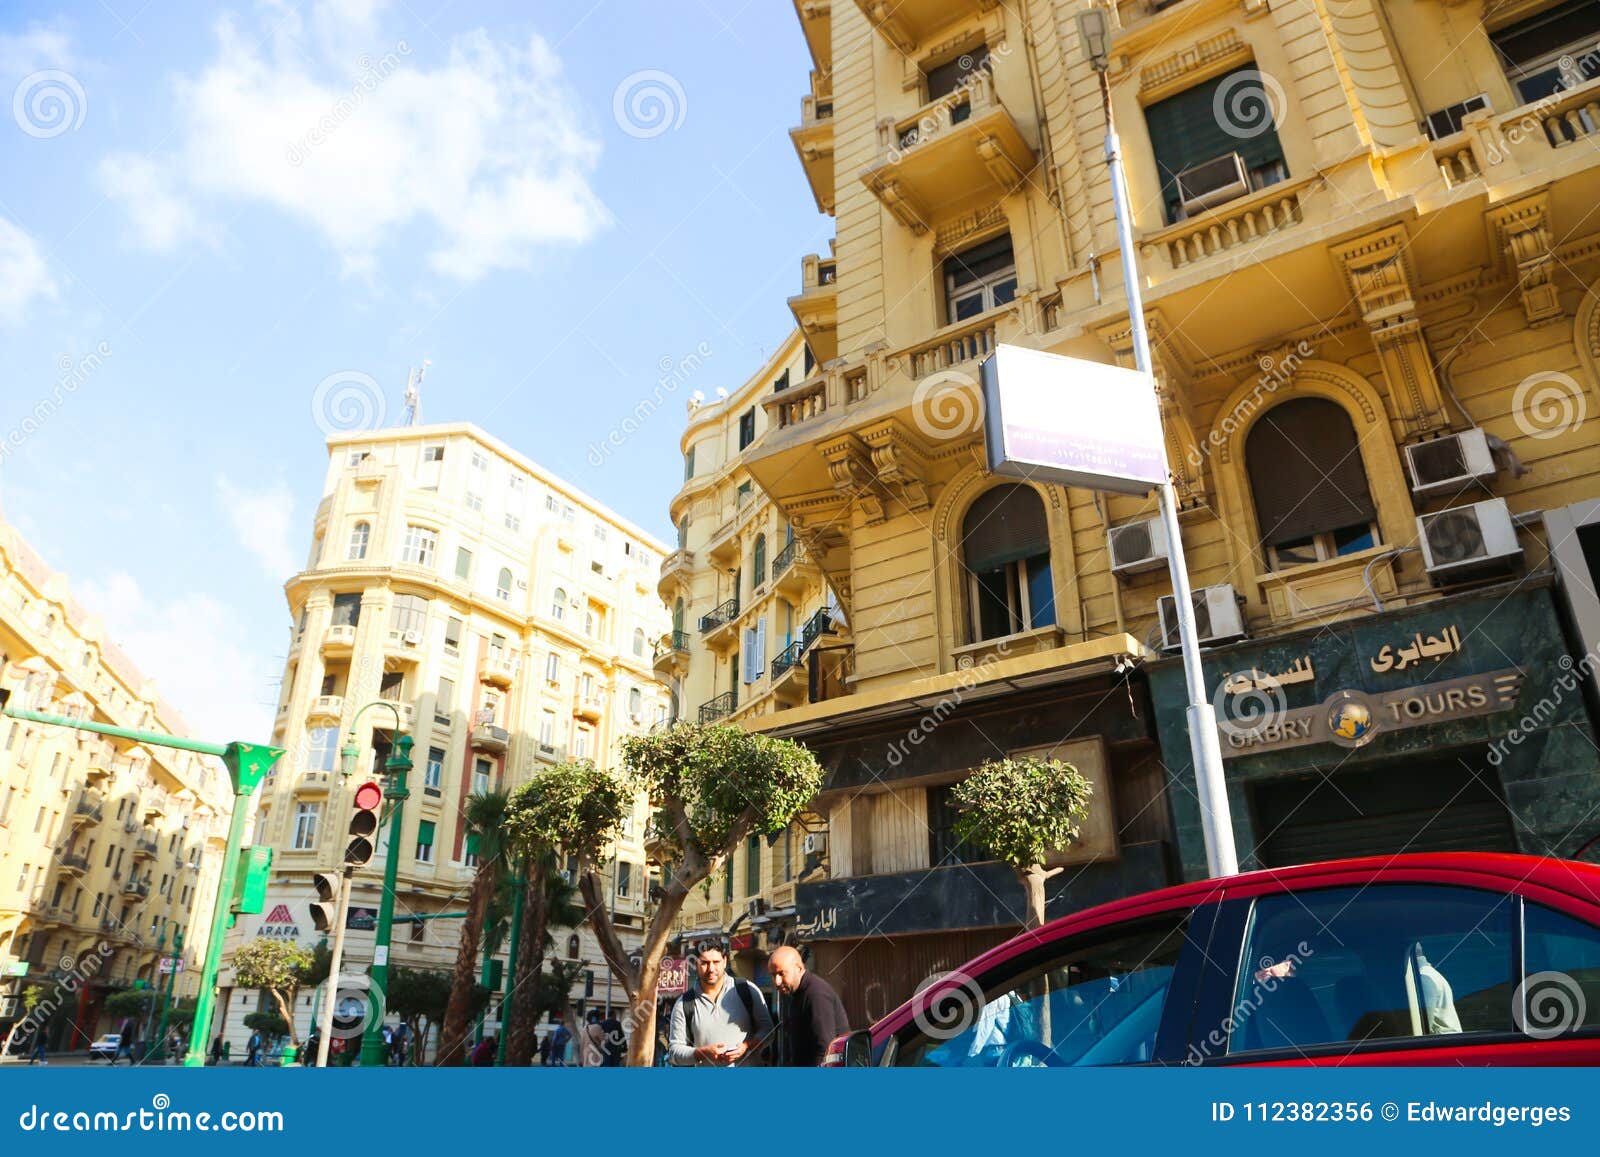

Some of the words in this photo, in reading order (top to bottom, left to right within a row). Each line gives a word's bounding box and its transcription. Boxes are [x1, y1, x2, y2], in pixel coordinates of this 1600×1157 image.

[1228, 716, 1313, 748] GABRY
[1386, 686, 1488, 721] TOURS
[257, 925, 299, 937] ARAFA
